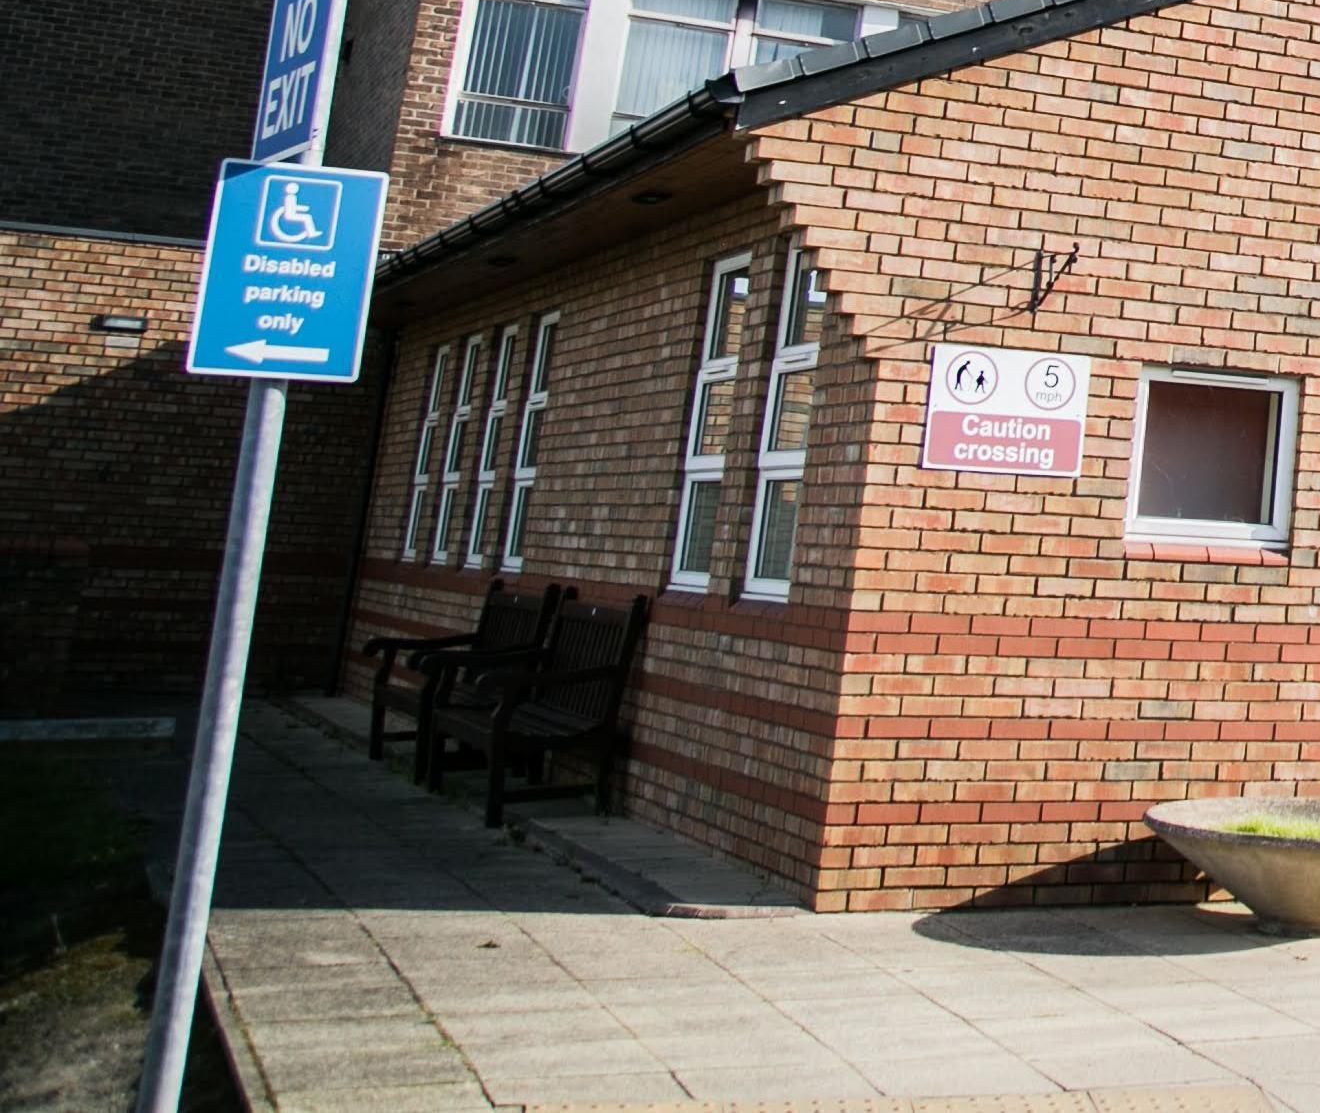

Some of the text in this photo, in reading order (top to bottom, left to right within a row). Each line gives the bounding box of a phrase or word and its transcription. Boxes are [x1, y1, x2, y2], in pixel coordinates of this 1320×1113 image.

[261, 60, 317, 140] EXIT
[243, 254, 336, 277] Disabled
[243, 285, 326, 309] parking
[257, 313, 305, 335] only
[1044, 365, 1060, 388] 5
[1035, 390, 1062, 403] mph
[961, 414, 1052, 441] Caution
[953, 443, 1054, 469] crossing
